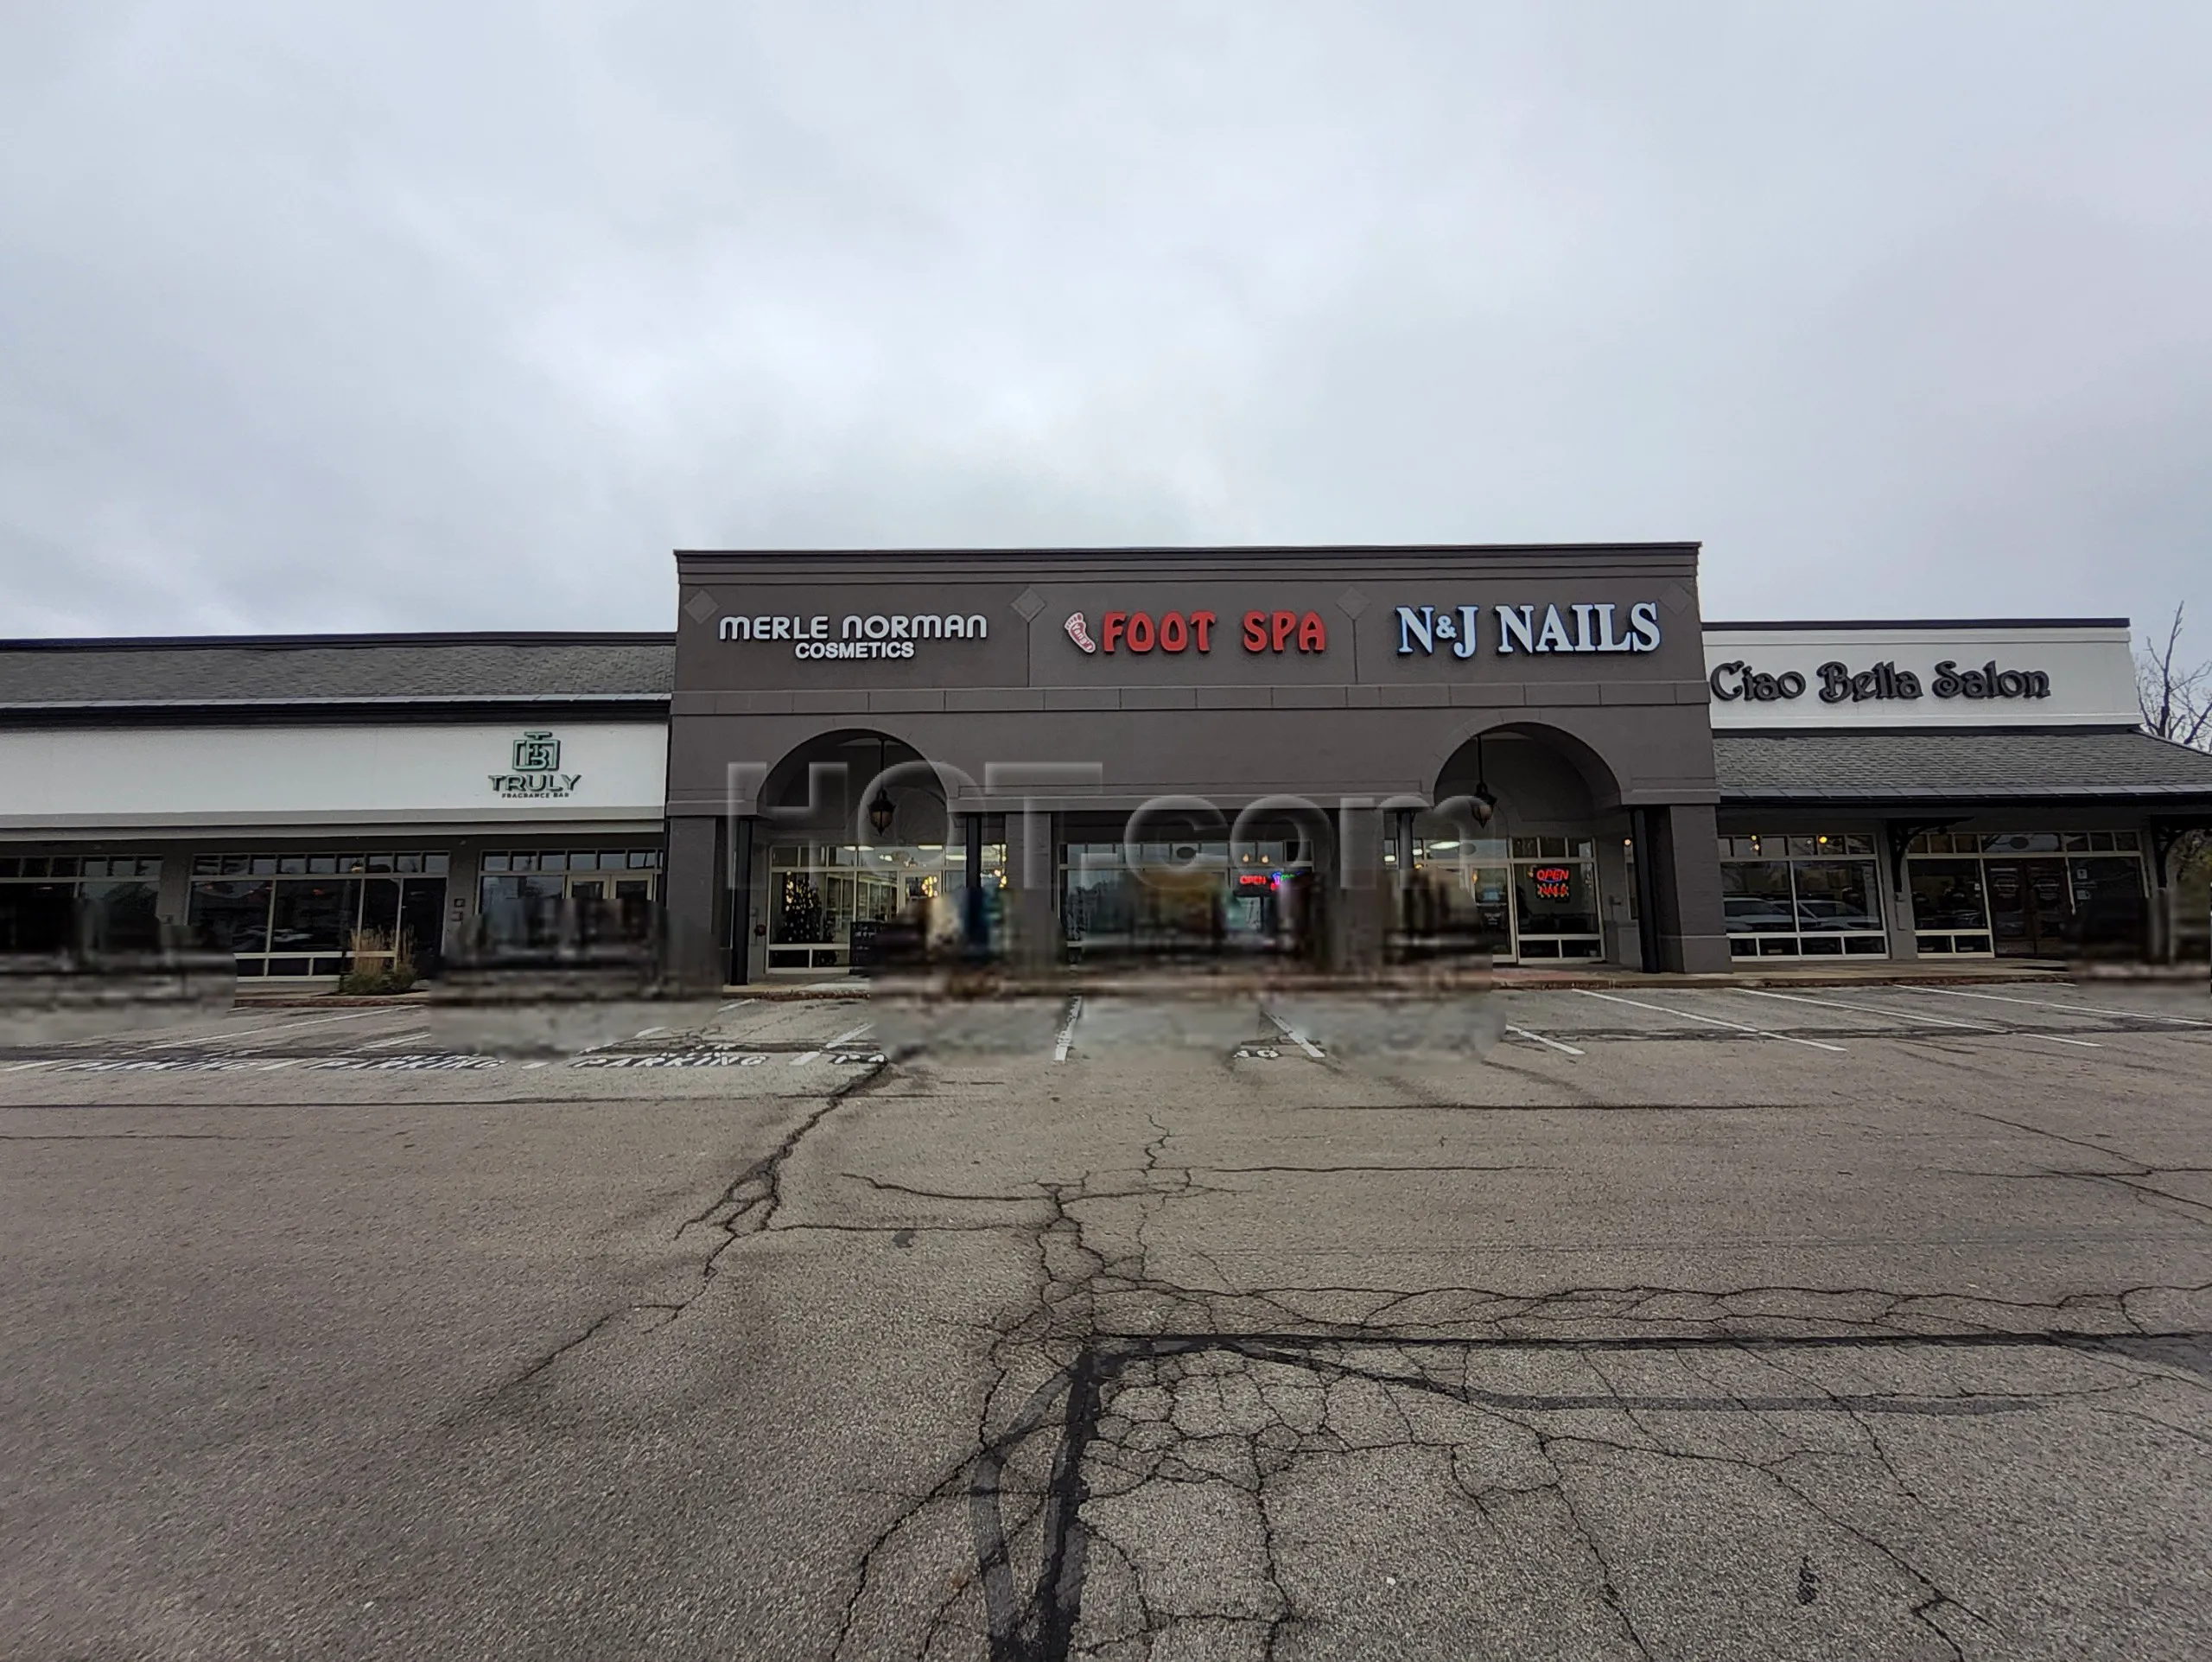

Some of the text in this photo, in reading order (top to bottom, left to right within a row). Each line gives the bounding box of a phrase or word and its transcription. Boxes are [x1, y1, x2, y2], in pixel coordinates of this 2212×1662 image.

[719, 614, 988, 640] MERLE NORMAN
[1103, 610, 1326, 653] FOOT SPA
[1395, 602, 1662, 658] N&J NAILS
[795, 641, 915, 659] COSMETICS
[1709, 659, 2051, 704] Ciao Bella Salon
[488, 774, 582, 792] TRULY
[1536, 869, 1569, 882] OPEN
[573, 1056, 767, 1067] PARKING
